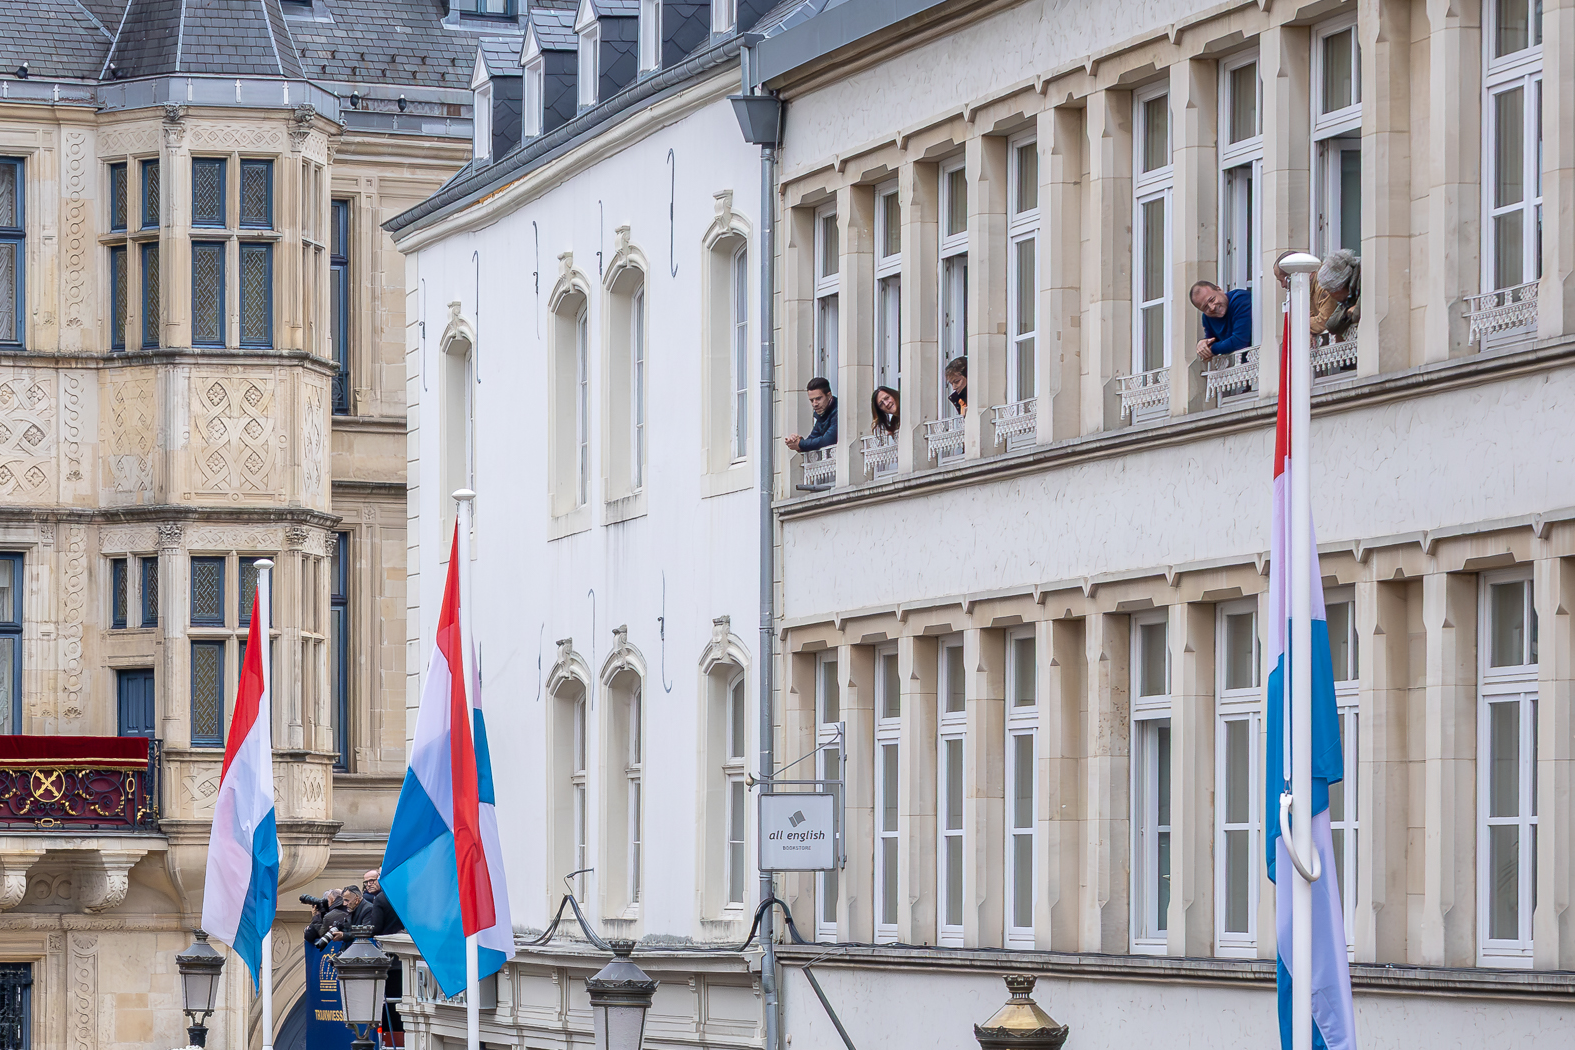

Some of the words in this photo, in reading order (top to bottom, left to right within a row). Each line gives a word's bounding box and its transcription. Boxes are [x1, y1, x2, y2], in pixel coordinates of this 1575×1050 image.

[768, 830, 783, 840] all
[786, 829, 825, 842] english
[314, 1009, 344, 1021] TROUNWIESS
